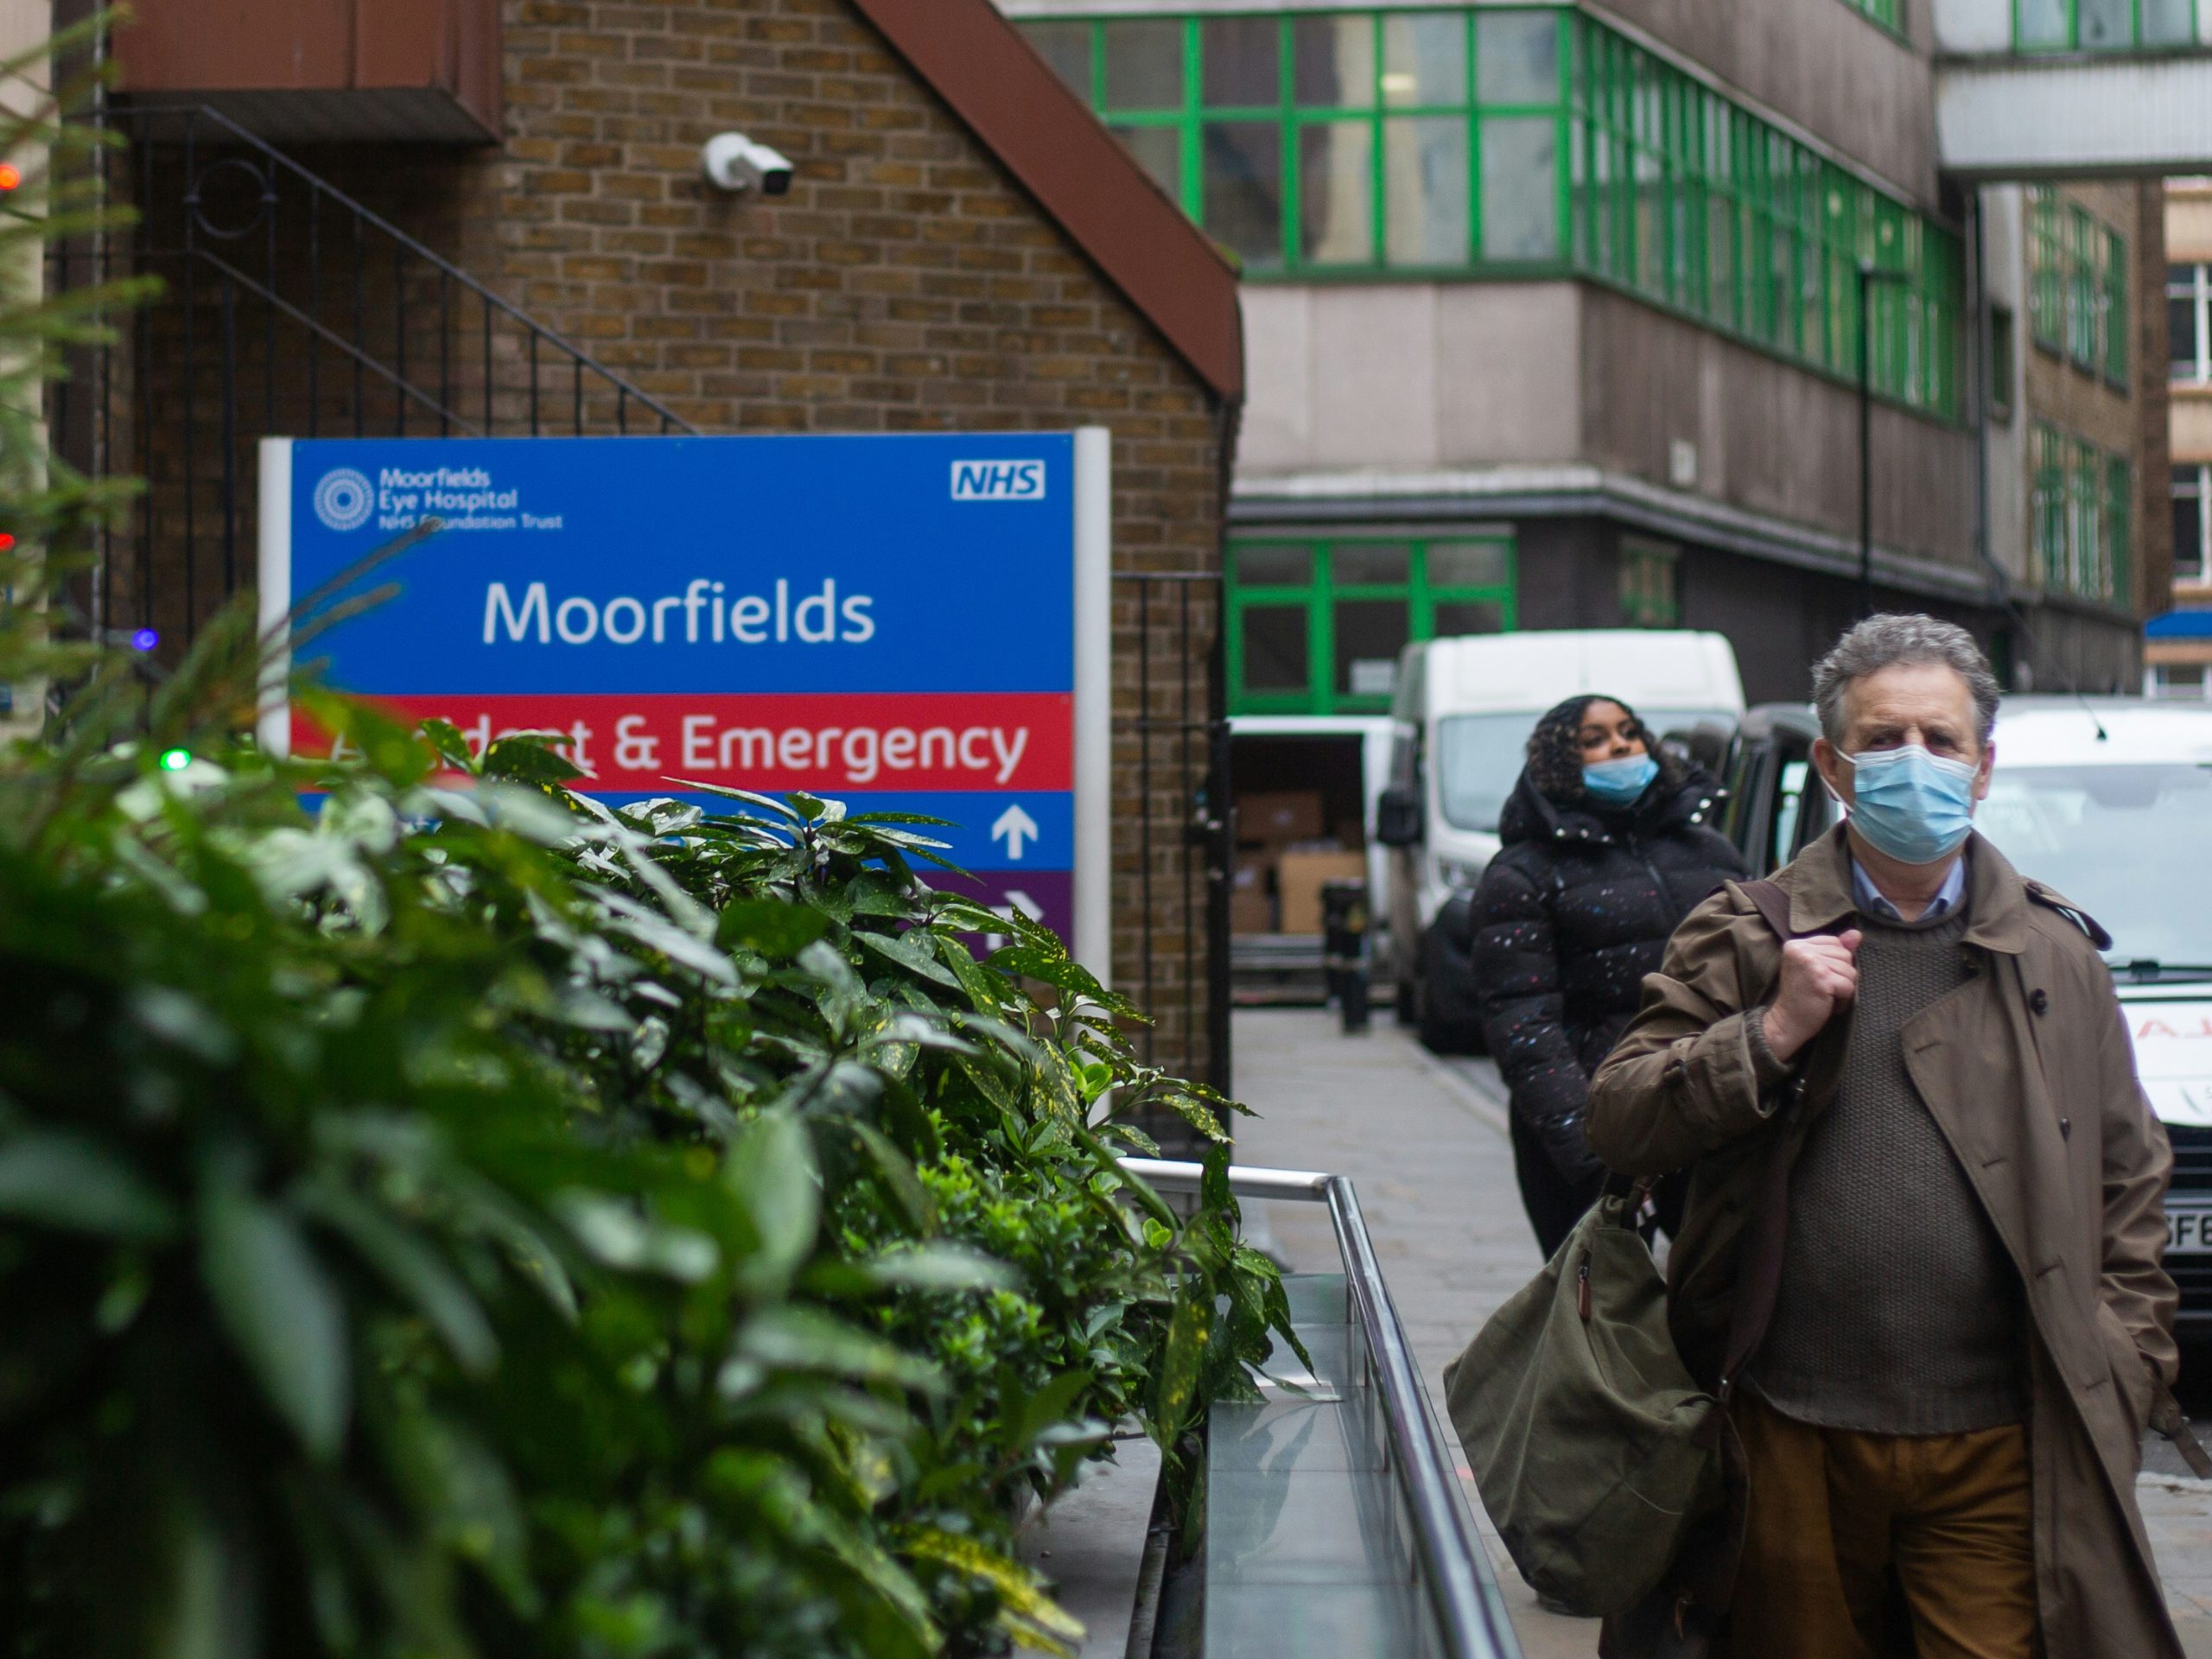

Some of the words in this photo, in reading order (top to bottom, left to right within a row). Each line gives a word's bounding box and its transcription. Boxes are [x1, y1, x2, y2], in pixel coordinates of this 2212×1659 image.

[379, 467, 491, 488] Moorfields
[956, 465, 1039, 495] NHS
[378, 489, 419, 514] Eye
[424, 488, 518, 513] Hospital
[378, 515, 416, 530] NHS
[521, 512, 563, 530] Trust
[482, 577, 876, 645] Moorfields
[613, 715, 660, 771] &
[682, 714, 1029, 785] Emergency
